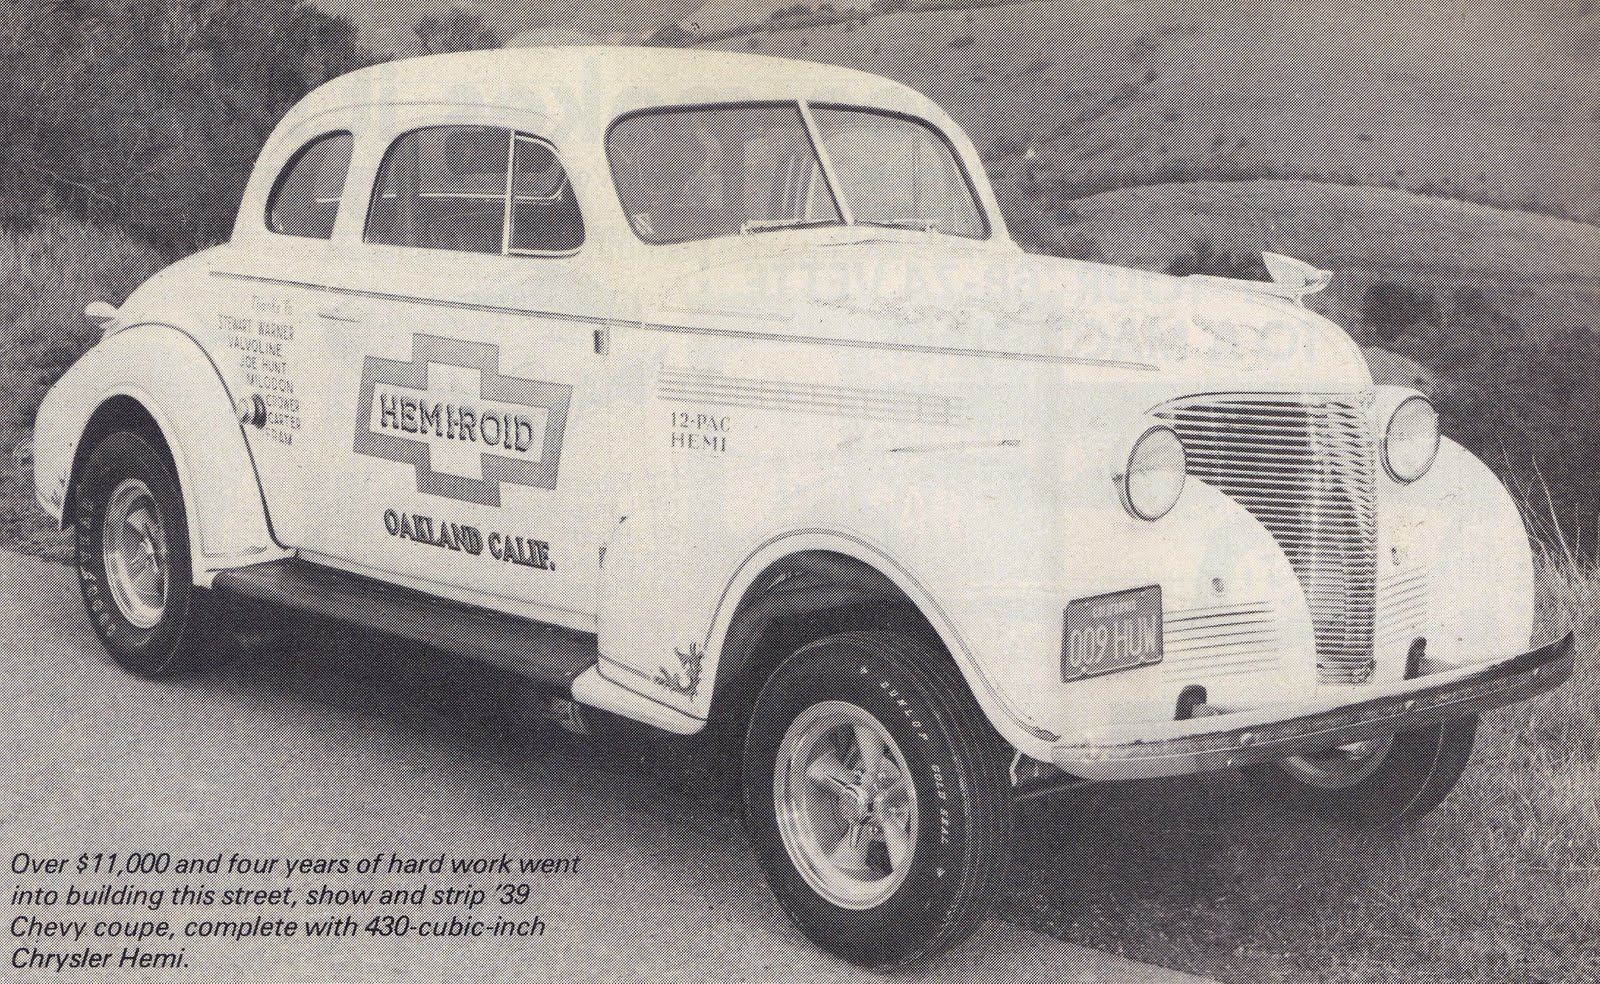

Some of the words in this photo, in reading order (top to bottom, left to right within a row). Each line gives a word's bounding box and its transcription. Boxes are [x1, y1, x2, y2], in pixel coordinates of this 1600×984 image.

[218, 313, 252, 332] STEWART
[258, 321, 294, 340] WARNER
[228, 335, 282, 357] VALVOLINE
[240, 355, 257, 370] JOE
[262, 359, 287, 374] HUNT
[246, 373, 294, 394] MILODON
[267, 412, 301, 429] CARTER
[671, 411, 731, 433] 12-PAC
[671, 431, 727, 453] HEMI
[383, 508, 484, 556] OAKLAND
[487, 531, 556, 571] CALIF.
[1069, 624, 1108, 668] 009
[1113, 614, 1157, 660] HUW
[879, 680, 930, 742] DUNLOP
[930, 763, 947, 801] GOLD
